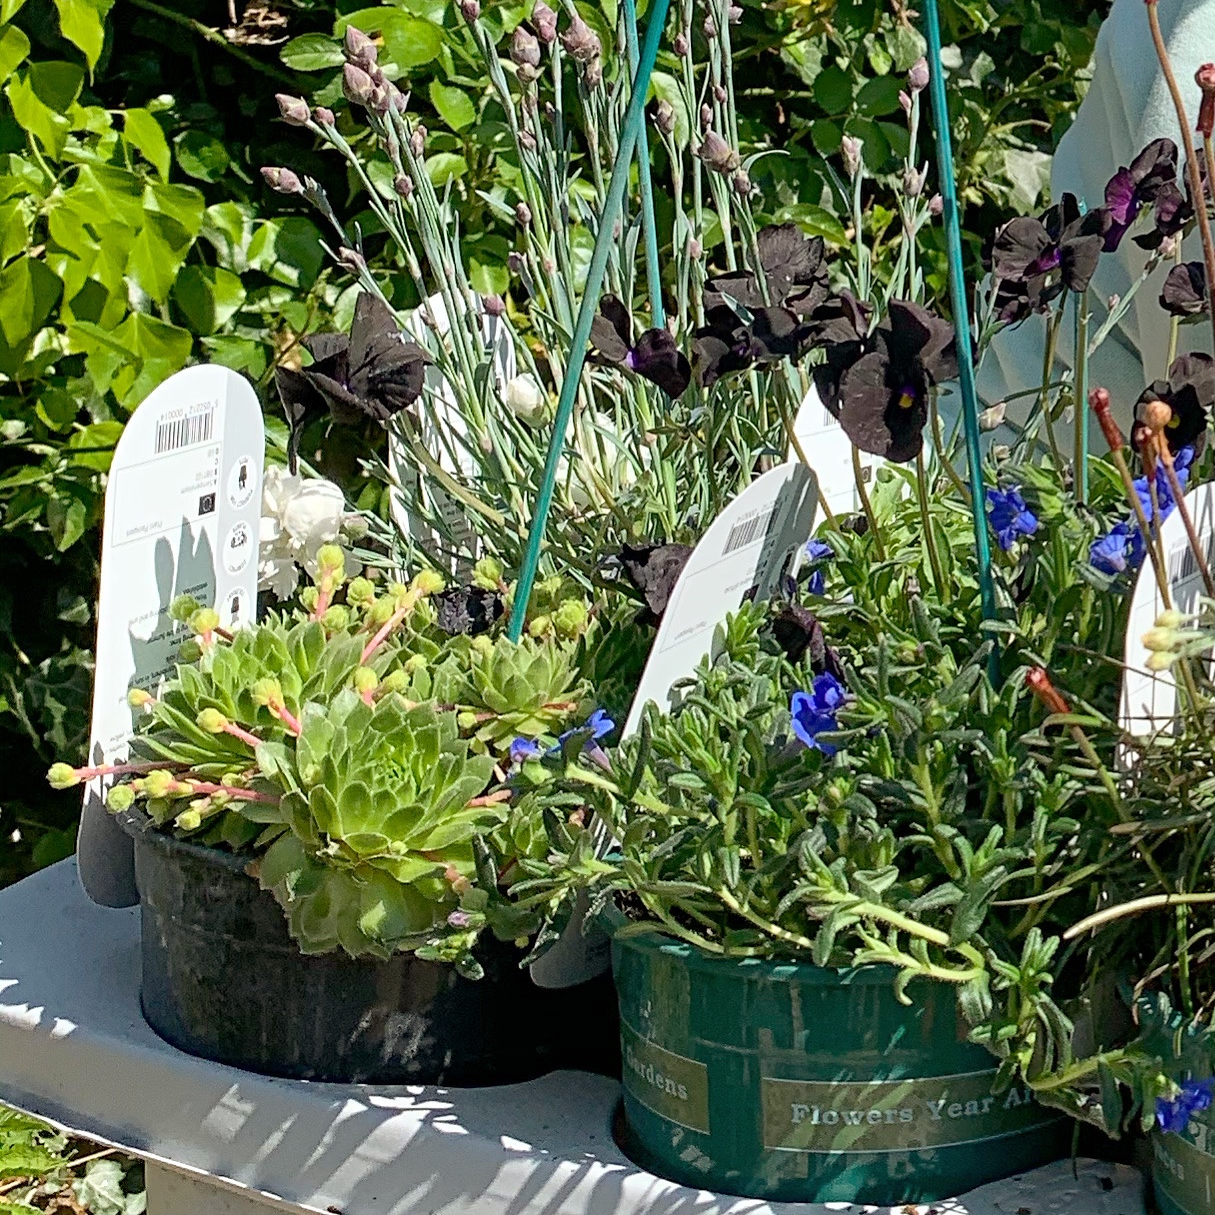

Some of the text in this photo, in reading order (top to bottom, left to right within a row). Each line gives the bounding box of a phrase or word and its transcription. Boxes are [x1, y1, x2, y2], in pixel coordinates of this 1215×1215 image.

[626, 1044, 689, 1101] Gardens
[790, 1103, 914, 1126] Flowers
[926, 1095, 995, 1121] Year
